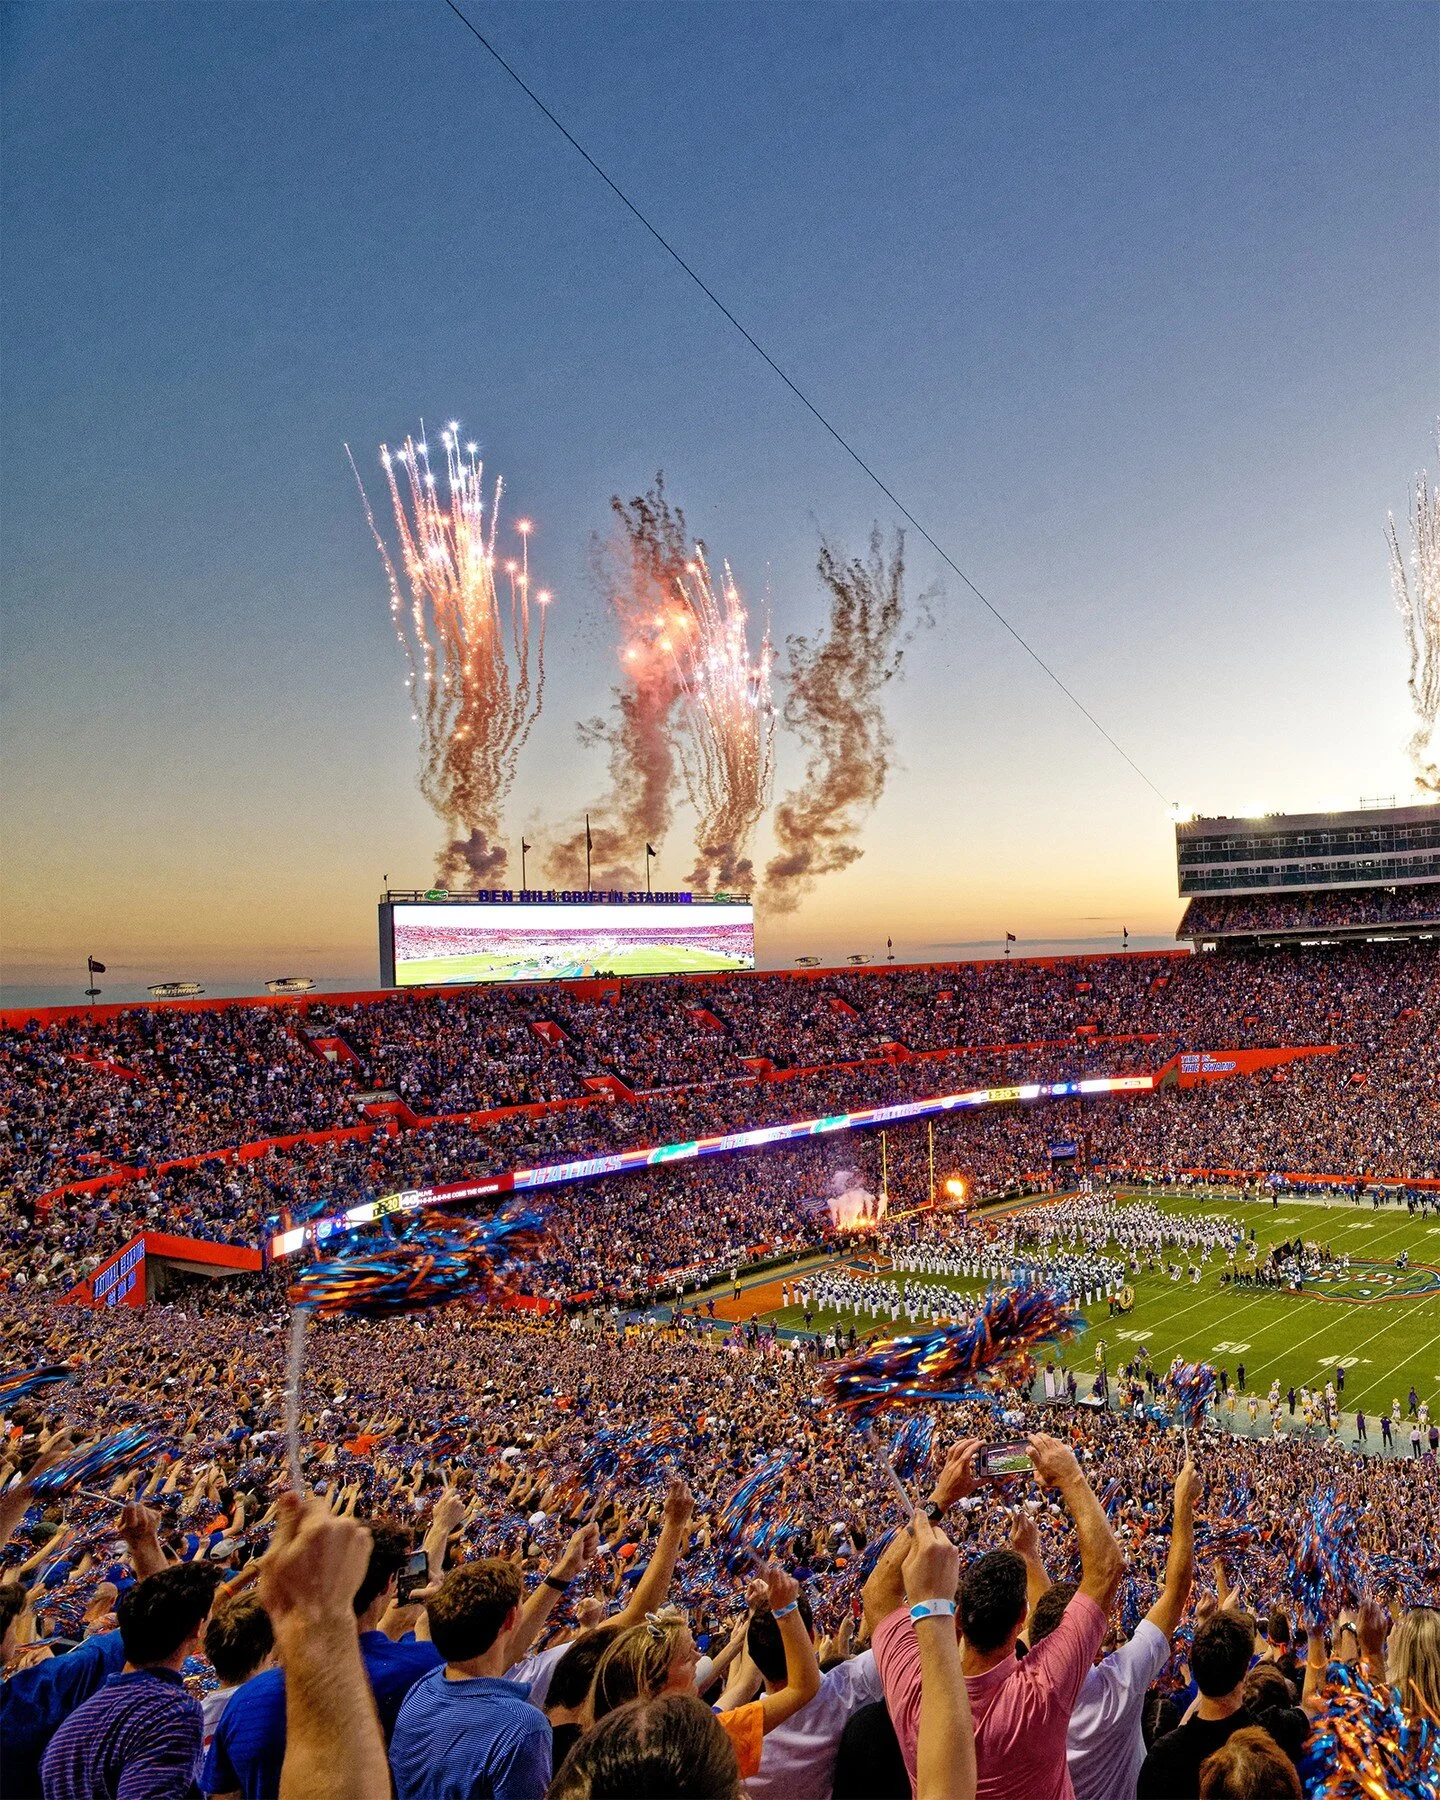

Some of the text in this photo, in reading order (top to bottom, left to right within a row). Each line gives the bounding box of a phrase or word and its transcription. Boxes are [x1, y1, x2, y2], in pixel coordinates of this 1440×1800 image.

[478, 890, 692, 903] BEN HILL GRIFFIN STADIUM
[1202, 1061, 1236, 1072] SWAMP
[528, 1155, 622, 1186] GATORS
[1115, 1329, 1154, 1342] 40
[1211, 1340, 1252, 1354] 50
[1317, 1354, 1360, 1369] 40
